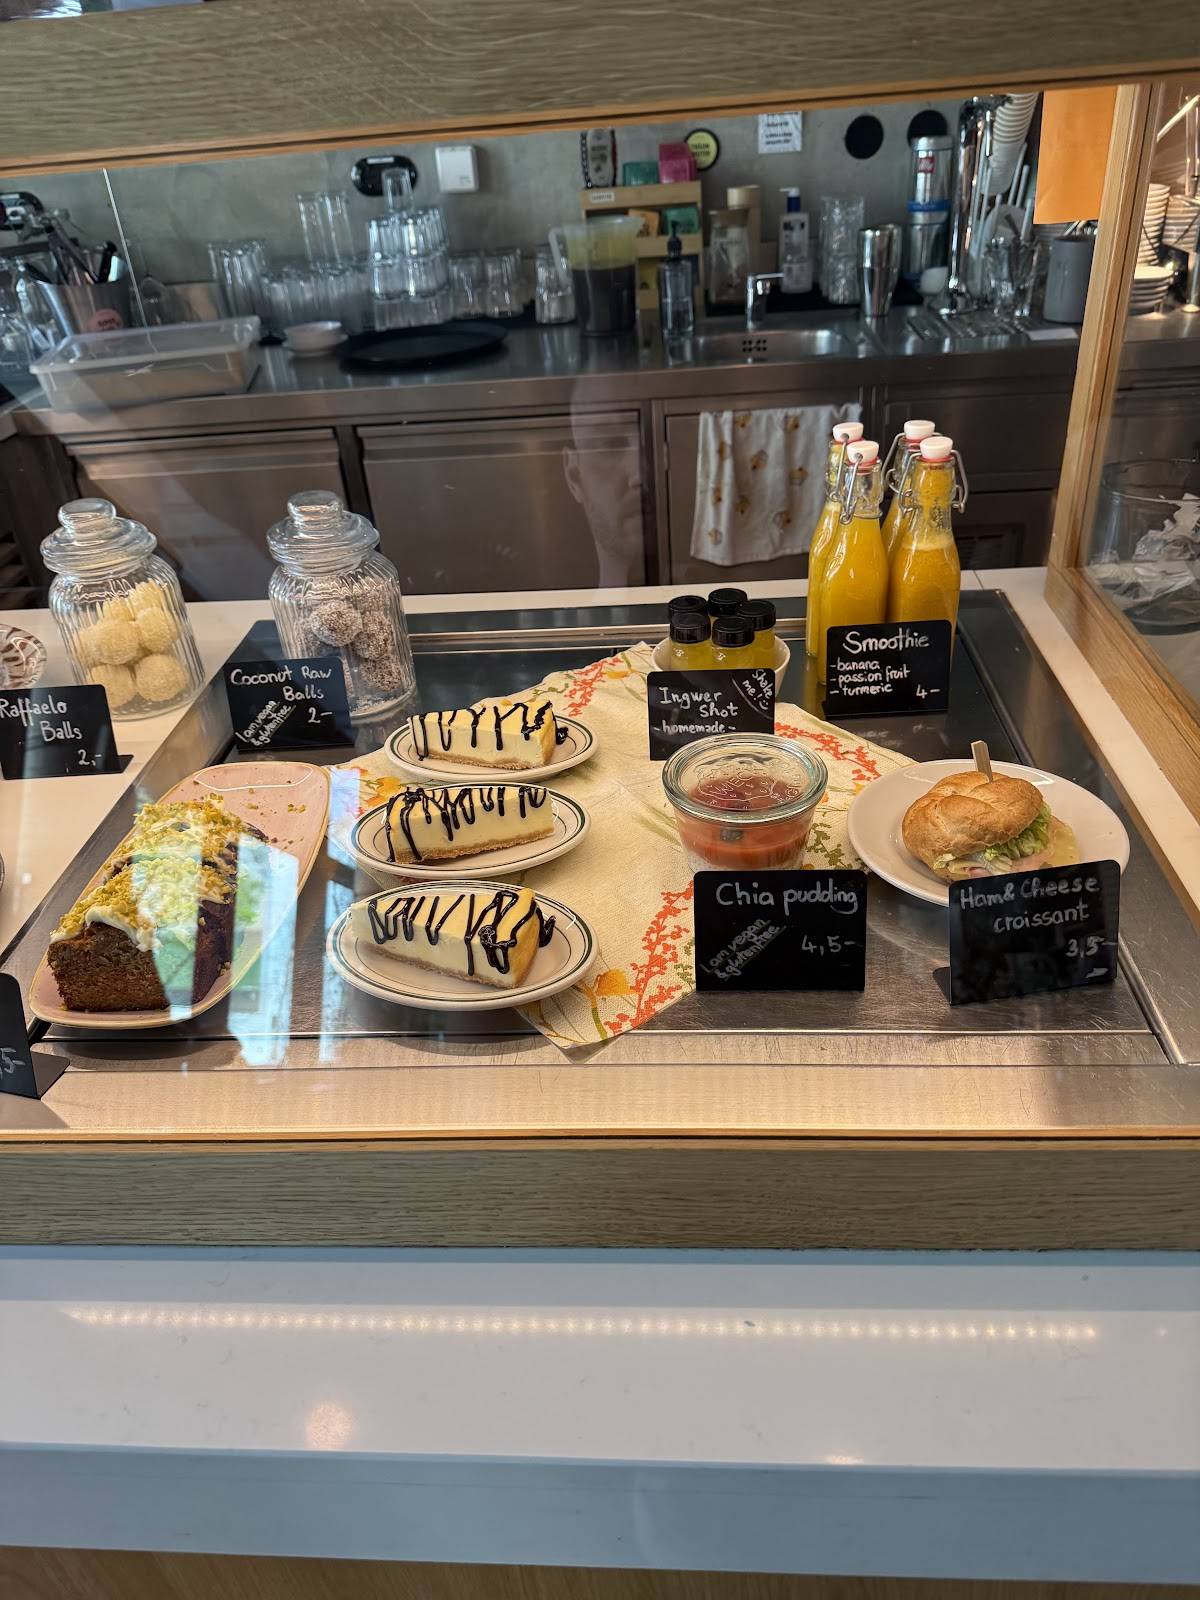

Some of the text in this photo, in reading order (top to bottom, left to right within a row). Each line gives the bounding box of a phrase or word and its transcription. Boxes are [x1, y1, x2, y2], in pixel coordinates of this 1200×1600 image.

[842, 627, 930, 654] Smoothie
[230, 664, 332, 685] Coconut Raw
[752, 669, 774, 699] Shake
[885, 663, 911, 682] fruit
[283, 684, 325, 701] Balls
[658, 686, 723, 710] Ingwer
[0, 694, 68, 727] Raffaelo
[235, 700, 277, 743] I am vegan
[40, 720, 83, 742] Balls
[715, 877, 859, 916] Chia pudding
[1020, 877, 1100, 898] Cheese
[993, 900, 1090, 934] croissant
[710, 950, 730, 967] am
[728, 919, 767, 952] vegan
[801, 935, 856, 956] 4,5-
